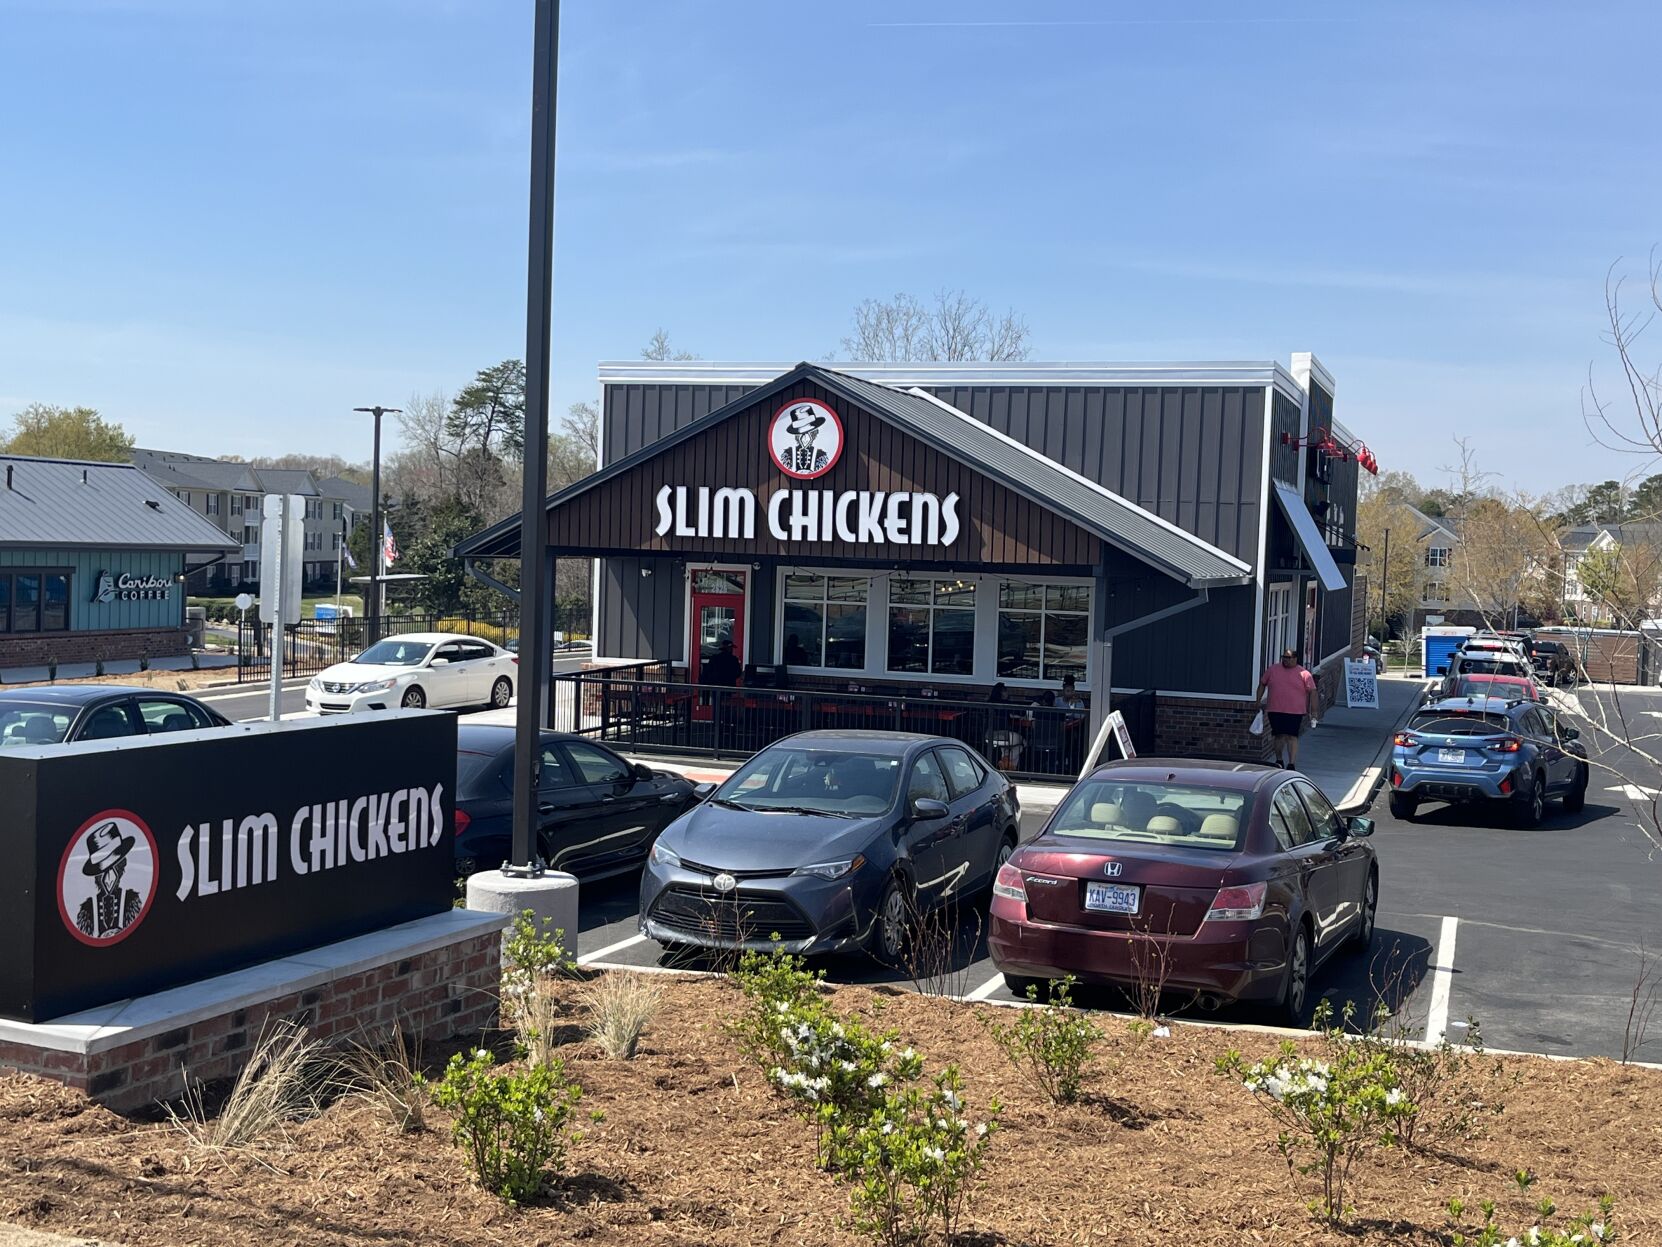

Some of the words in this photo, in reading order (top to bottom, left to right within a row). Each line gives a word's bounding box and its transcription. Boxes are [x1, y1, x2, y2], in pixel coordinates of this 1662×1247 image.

[655, 484, 755, 539] SLIM
[768, 488, 960, 547] CHICKENS
[118, 572, 173, 589] Caribou
[121, 590, 170, 601] COFFEE
[175, 812, 278, 902] SLIM
[290, 782, 444, 875] CHICKENS
[1089, 889, 1136, 907] KAV-9943
